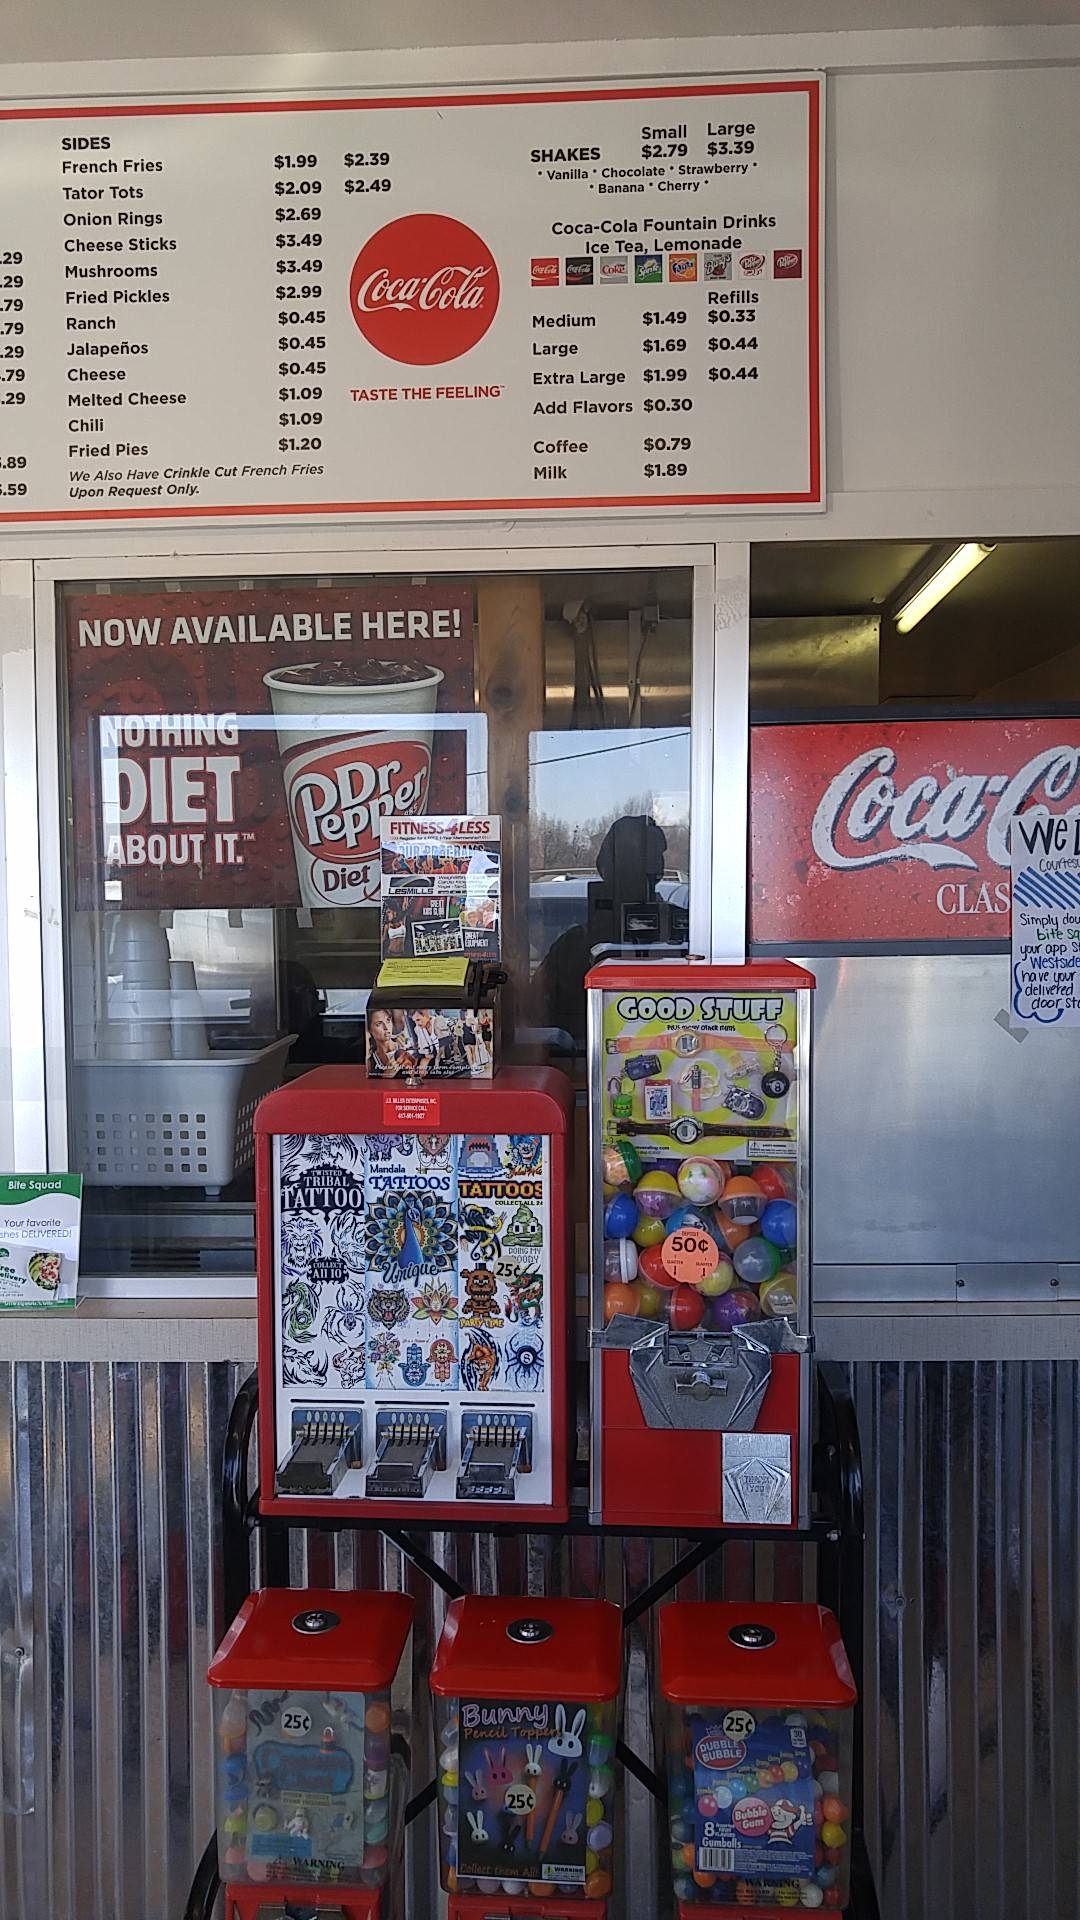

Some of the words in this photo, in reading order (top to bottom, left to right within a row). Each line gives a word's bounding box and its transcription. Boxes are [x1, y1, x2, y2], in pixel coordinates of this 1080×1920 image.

[642, 125, 686, 139] Small
[708, 123, 755, 137] Large
[62, 137, 110, 150] SIDES
[642, 144, 687, 159] $2.79
[708, 141, 754, 157] $3.39
[344, 153, 389, 168] $2.39
[531, 148, 600, 162] SHAKES
[63, 160, 117, 173] French
[124, 159, 162, 172] Fries
[275, 155, 317, 170] $1.99
[547, 169, 588, 180] Vanilla
[602, 166, 665, 178] Chocolate
[679, 164, 748, 174] Strawberry
[63, 188, 104, 199] Tator
[110, 187, 143, 198] Tots
[275, 181, 321, 196] $2.09
[345, 179, 391, 194] $2.49
[599, 184, 644, 193] Banana
[658, 181, 699, 192] Cherry
[64, 213, 111, 226] Onion
[118, 212, 162, 226] Rings
[276, 208, 321, 222] $2.69
[552, 219, 637, 234] Coca-Cola
[644, 216, 716, 231] Fountain
[724, 214, 776, 228] Drinks
[65, 239, 123, 252] Cheese
[129, 237, 176, 250] Sticks
[276, 234, 322, 248] $3.49
[586, 242, 609, 254] Ice
[615, 240, 648, 254] Tea,
[655, 236, 742, 251] Lemonade
[66, 265, 157, 278] Mushrooms
[277, 260, 322, 274] $3.49
[276, 286, 321, 300] $2.99
[357, 265, 493, 312] Coca-Cola
[66, 291, 107, 304] Fried
[114, 290, 169, 303] Pickles
[709, 290, 758, 304] Refills
[67, 316, 115, 329] Ranch
[279, 311, 325, 326] $0.45
[533, 314, 595, 328] Medium
[643, 312, 686, 326] $1.49
[708, 310, 755, 324] $0.33
[67, 342, 148, 357] Jalapeños
[279, 337, 325, 351] $0.45
[533, 343, 578, 357] Large
[643, 339, 686, 353] $1.69
[709, 337, 758, 352] $0.44
[68, 368, 125, 381] Cheese
[279, 362, 325, 376] $0.45
[644, 369, 687, 383] $1.99
[709, 367, 758, 382] $0.44
[534, 373, 574, 384] Extra
[581, 372, 625, 385] Large
[69, 393, 122, 406] Melted
[129, 392, 186, 405] Cheese
[279, 387, 322, 401] $1.09
[351, 388, 397, 402] TASTE
[402, 388, 431, 401] THE
[533, 401, 566, 414] Add
[574, 401, 632, 413] Flavors
[644, 399, 692, 413] $0.30
[69, 419, 103, 432] Chili
[279, 413, 322, 426] $1.09
[69, 444, 109, 457] Fried
[116, 443, 148, 456] Pies
[279, 438, 321, 452] $1.20
[534, 440, 588, 453] Coffee
[644, 438, 691, 452] $0.79
[70, 471, 90, 481] We
[94, 470, 122, 480] Also
[127, 470, 159, 480] Have
[164, 467, 210, 478] Crinkle
[215, 467, 237, 477] Cut
[242, 465, 286, 476] French
[292, 464, 324, 475] Fries
[535, 466, 566, 479] Milk
[644, 464, 687, 478] $1.89
[70, 487, 104, 499] Upon
[108, 485, 162, 497] Request
[167, 484, 199, 496] Only.
[78, 617, 160, 647] NOW
[170, 612, 352, 645] AVAILABLE
[362, 609, 462, 639] HERE!
[100, 713, 239, 748] NOTHING
[103, 756, 240, 825] DIET
[334, 760, 401, 809] Dr
[291, 766, 427, 848] Pepper
[1019, 818, 1067, 854] We
[105, 834, 202, 865] ABOUT
[323, 865, 370, 891] Diet
[936, 883, 1011, 914] CLAS
[1020, 913, 1058, 928] Simply
[1037, 929, 1063, 940] bite
[1020, 944, 1042, 961] your
[1046, 944, 1067, 957] app
[1022, 970, 1049, 982] have
[1054, 972, 1076, 986] your
[1025, 983, 1073, 996] delivered
[617, 997, 694, 1021] GOOD
[701, 997, 783, 1021] STUFF
[1032, 998, 1060, 1010] door
[370, 1164, 405, 1173] Mandala
[8, 1181, 26, 1190] Bite
[29, 1180, 61, 1191] Squad
[304, 1176, 350, 1186] TRIBAL
[369, 1176, 450, 1191] TATTOOS
[281, 1184, 361, 1209] TATTOO
[459, 1181, 543, 1198] TATTOOS
[22, 1230, 71, 1238] DELIVERED!
[672, 1237, 708, 1253] 50¢
[382, 1261, 441, 1287] Unique
[496, 1262, 521, 1278] 25¢
[284, 1714, 310, 1729] 25¢
[462, 1703, 549, 1728] Bunny
[726, 1717, 753, 1733] 25¢
[464, 1727, 507, 1739] Pencil
[512, 1727, 561, 1737] Toppers
[700, 1740, 739, 1752] DUBBLE
[702, 1749, 742, 1763] BUBBLE
[507, 1794, 534, 1809] 25¢
[735, 1807, 768, 1820] Bubble
[705, 1822, 714, 1836] 8
[702, 1837, 742, 1848] Gumballs
[292, 1857, 345, 1870] WARNING
